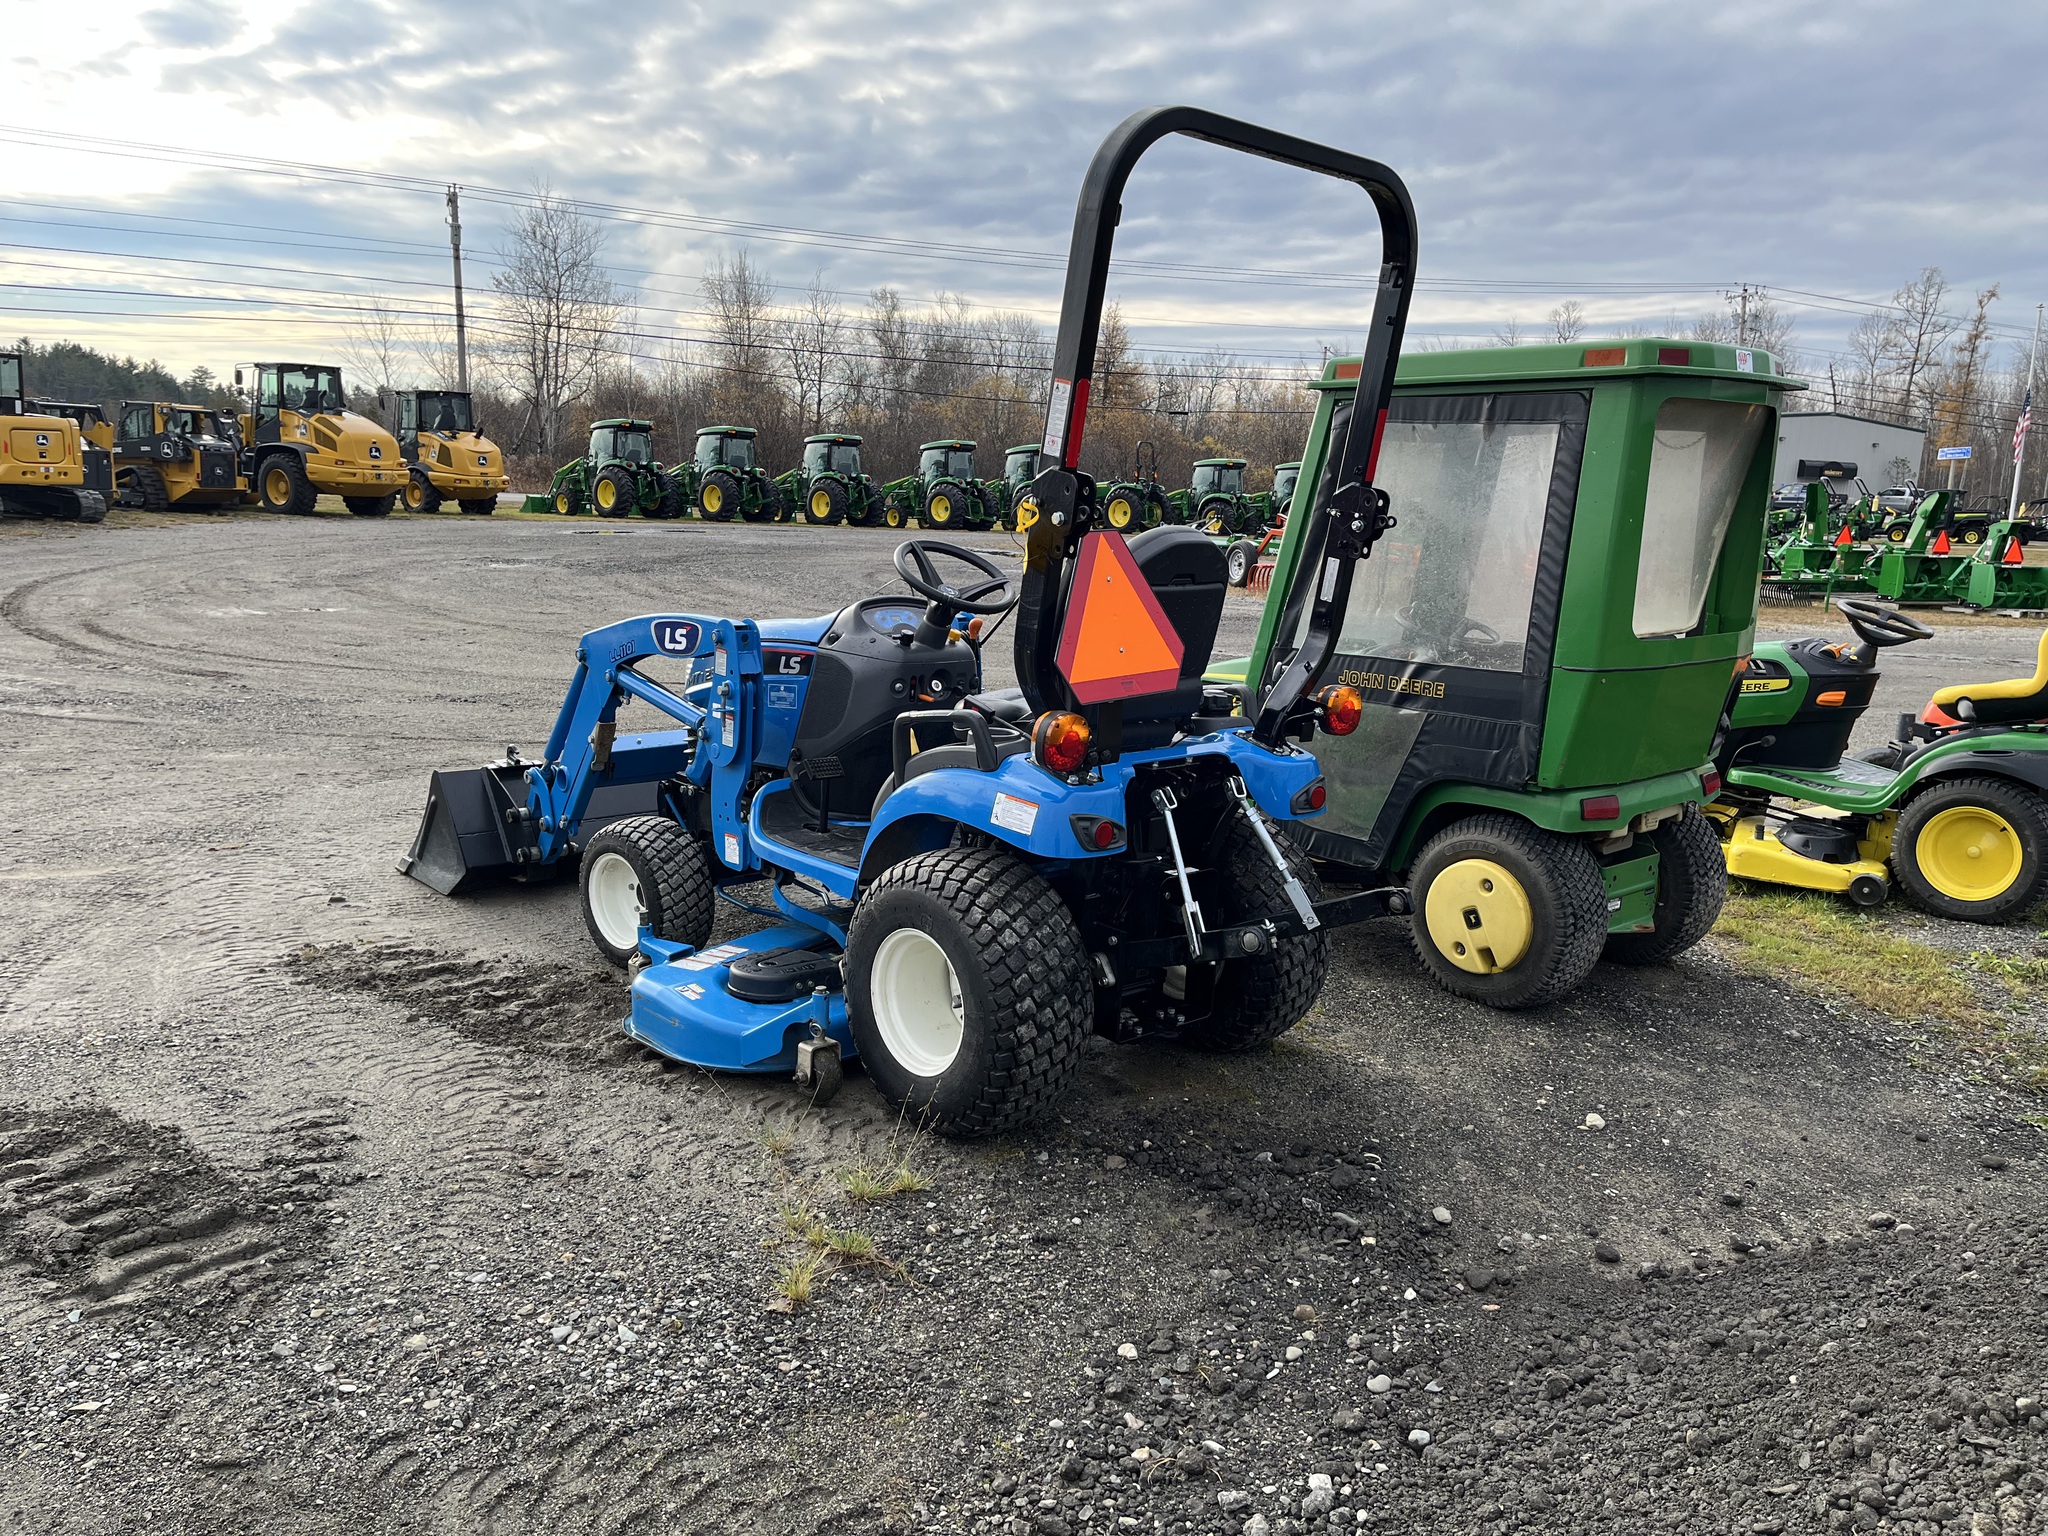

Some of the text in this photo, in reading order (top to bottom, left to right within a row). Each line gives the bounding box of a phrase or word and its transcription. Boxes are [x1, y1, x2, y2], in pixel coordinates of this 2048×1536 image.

[664, 627, 687, 651] LS
[609, 640, 636, 663] LL1101
[778, 655, 801, 675] LS
[1338, 669, 1445, 698] JOHN DEERE
[1740, 683, 1770, 691] EERE
